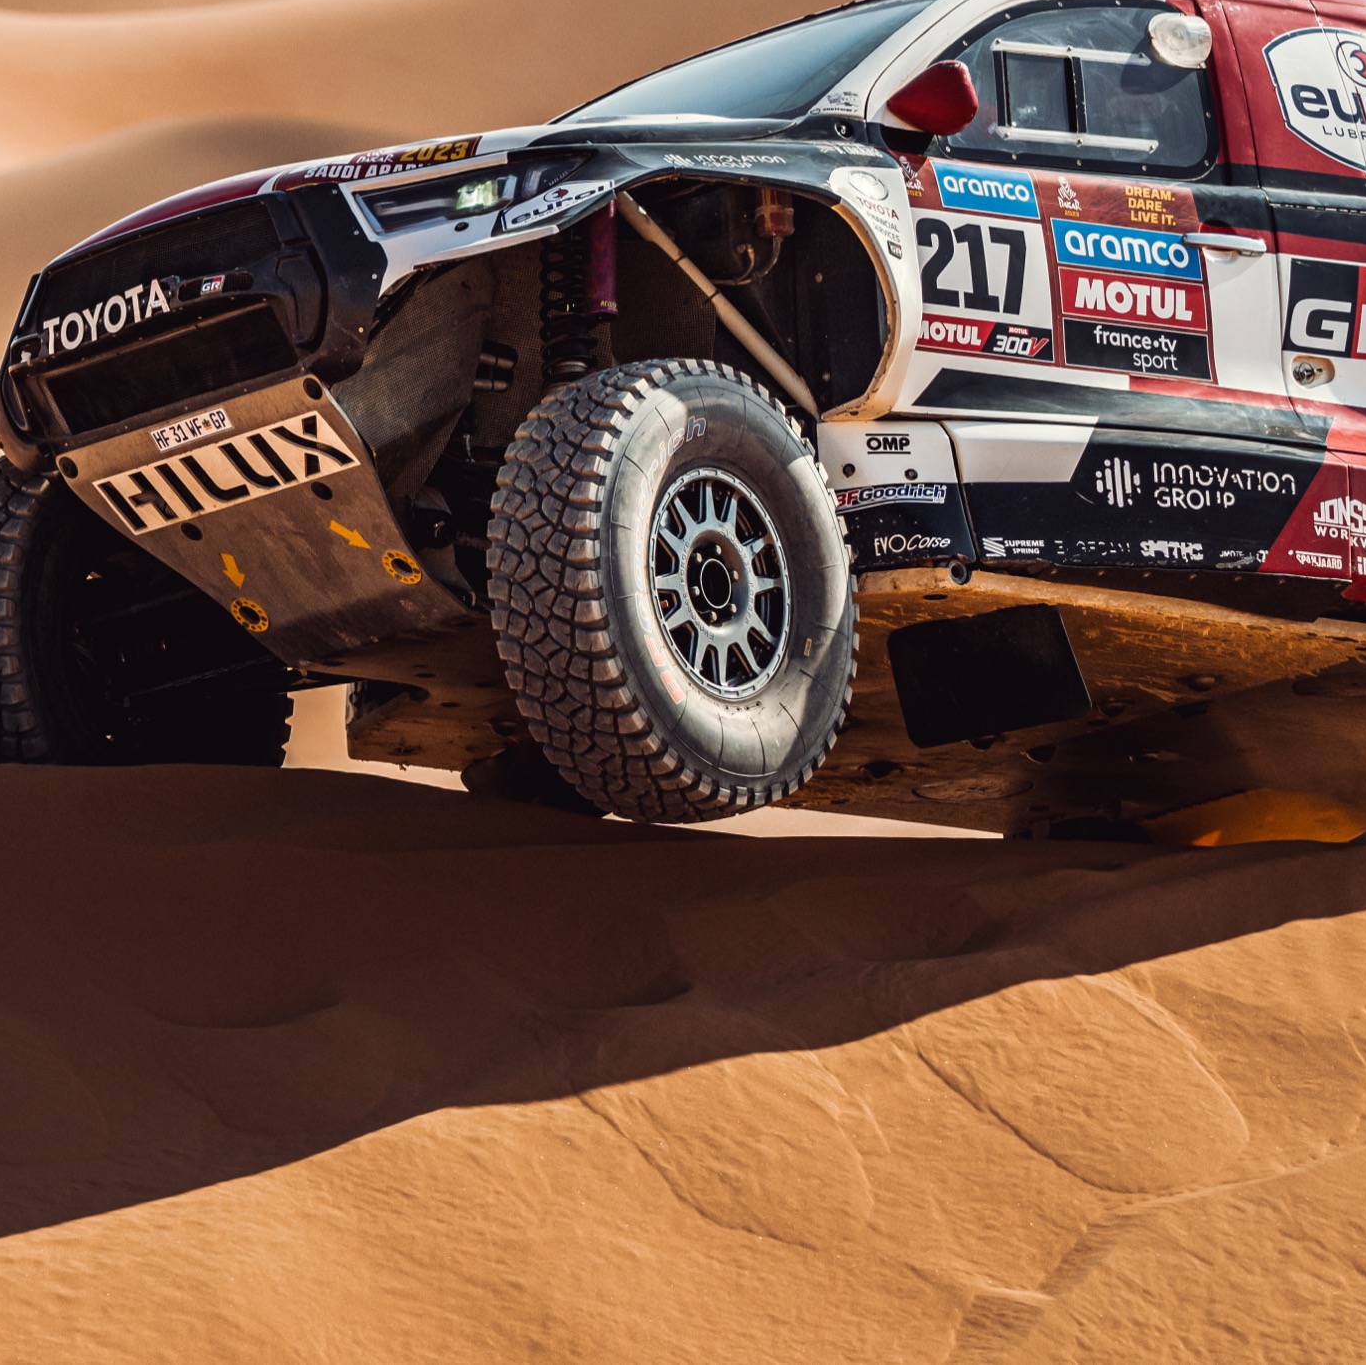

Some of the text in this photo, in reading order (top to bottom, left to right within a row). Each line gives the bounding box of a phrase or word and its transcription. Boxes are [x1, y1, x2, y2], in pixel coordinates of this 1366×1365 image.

[400, 141, 469, 162] 2023
[304, 165, 362, 179] SAUDI
[943, 175, 1030, 203] aramco
[1125, 185, 1175, 201] DREAM.
[856, 196, 899, 220] TOYOTA
[1064, 210, 1080, 218] 2023
[1128, 197, 1166, 212] DARE.
[1131, 210, 1176, 226] LIVE IT.
[1065, 230, 1189, 269] aramco
[916, 217, 1027, 316] 217
[202, 280, 221, 293] GR
[1075, 277, 1193, 322] MOTUL
[43, 278, 170, 355] TOYOTA
[1008, 326, 1029, 335] MOTUL
[992, 335, 1050, 358] 300V
[1133, 352, 1178, 373] sport
[153, 429, 169, 449] HF
[169, 424, 189, 443] 31
[209, 410, 226, 429] GP
[866, 437, 910, 451] OMP
[97, 414, 355, 531] HILUX
[1004, 539, 1045, 547] SUPREME
[1012, 547, 1040, 555] SPRING
